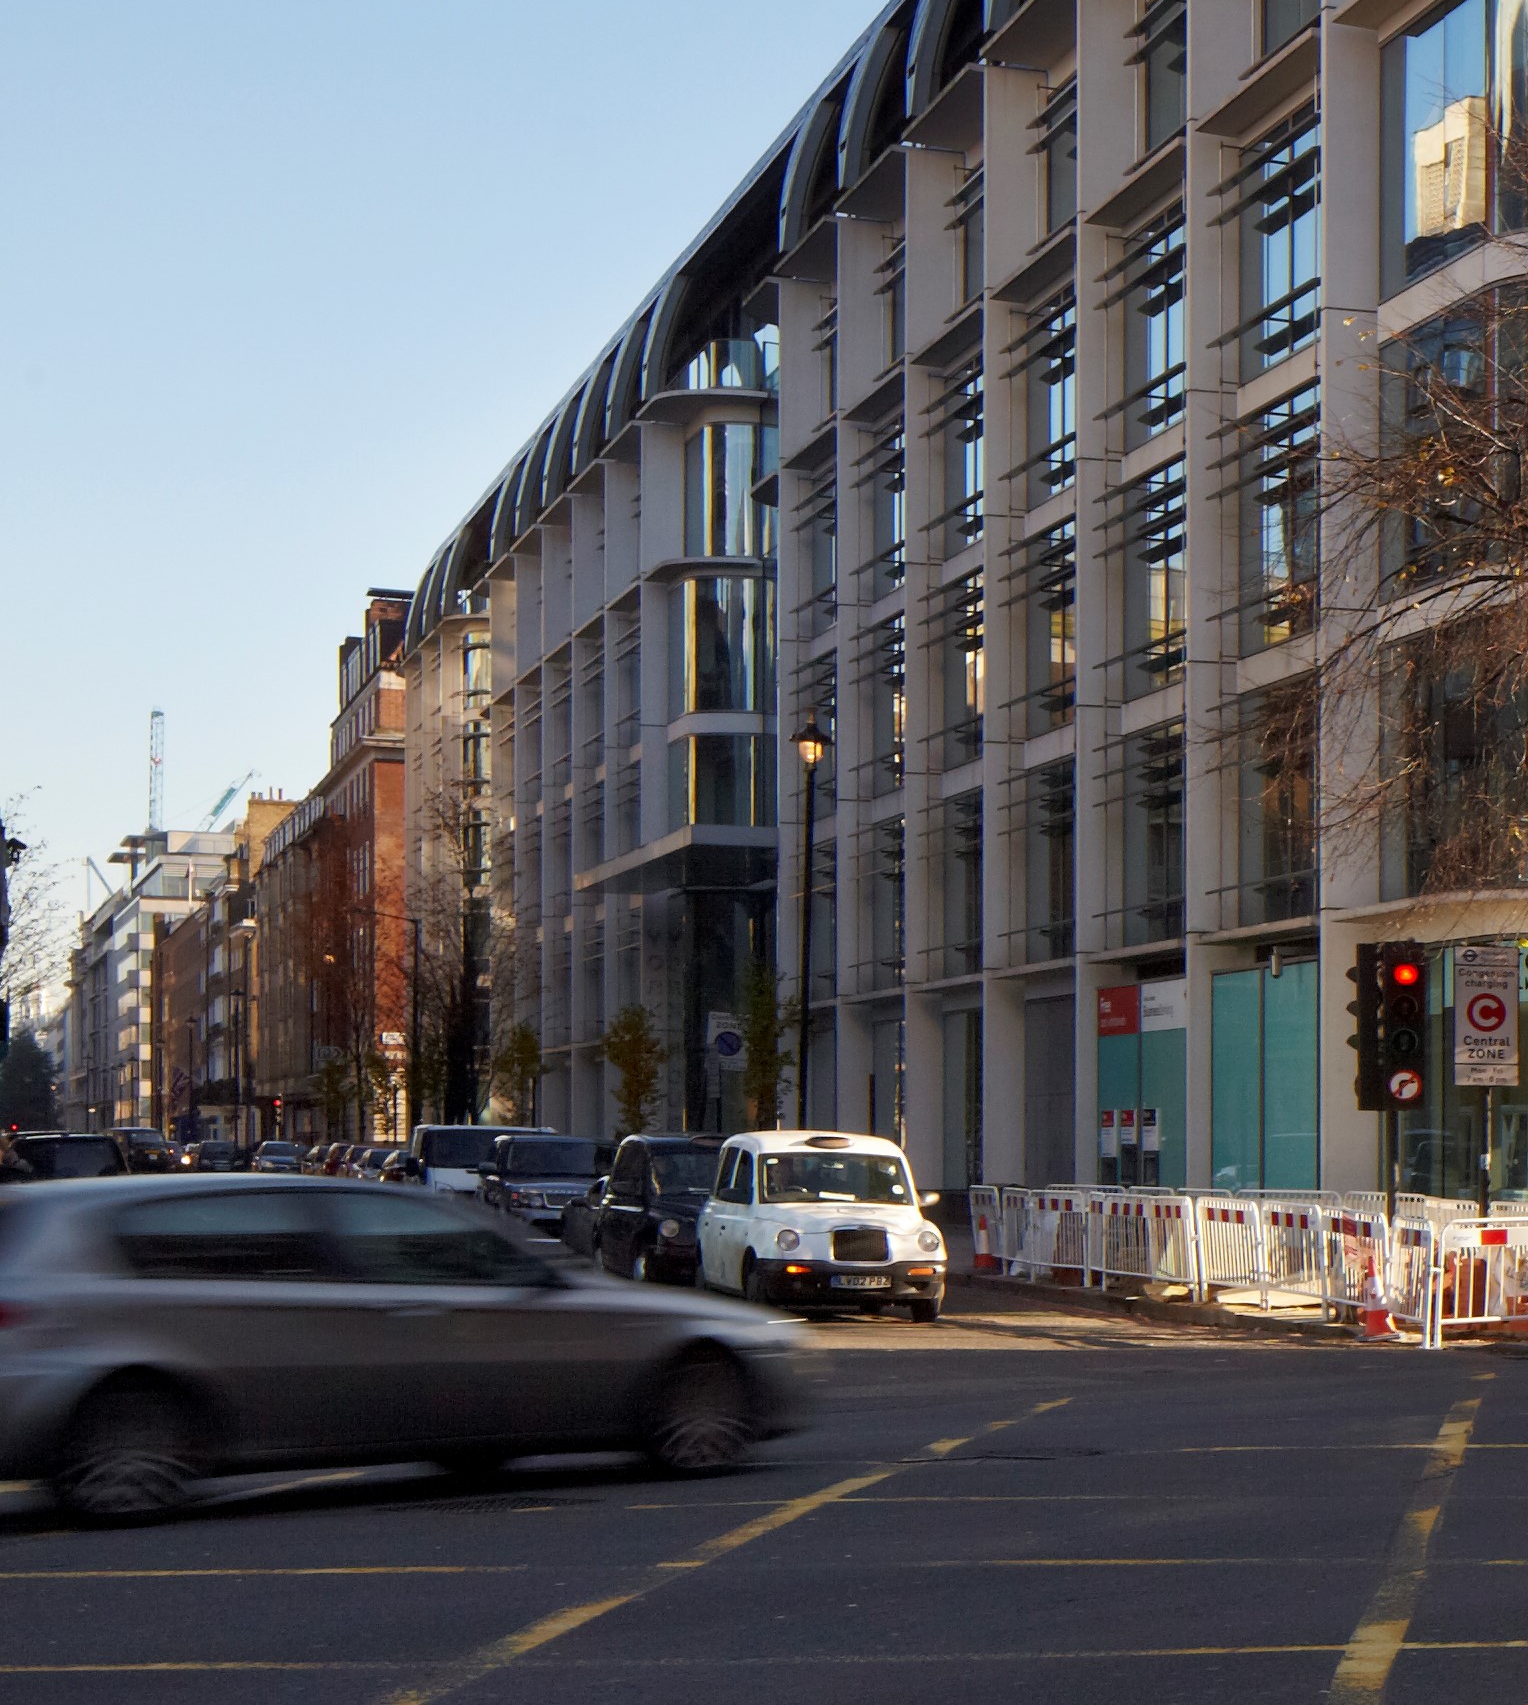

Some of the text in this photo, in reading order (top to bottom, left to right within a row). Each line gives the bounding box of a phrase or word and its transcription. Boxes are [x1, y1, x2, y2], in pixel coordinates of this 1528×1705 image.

[1464, 979, 1509, 990] charging
[1463, 1035, 1511, 1047] Central
[1467, 1048, 1506, 1060] ZONE
